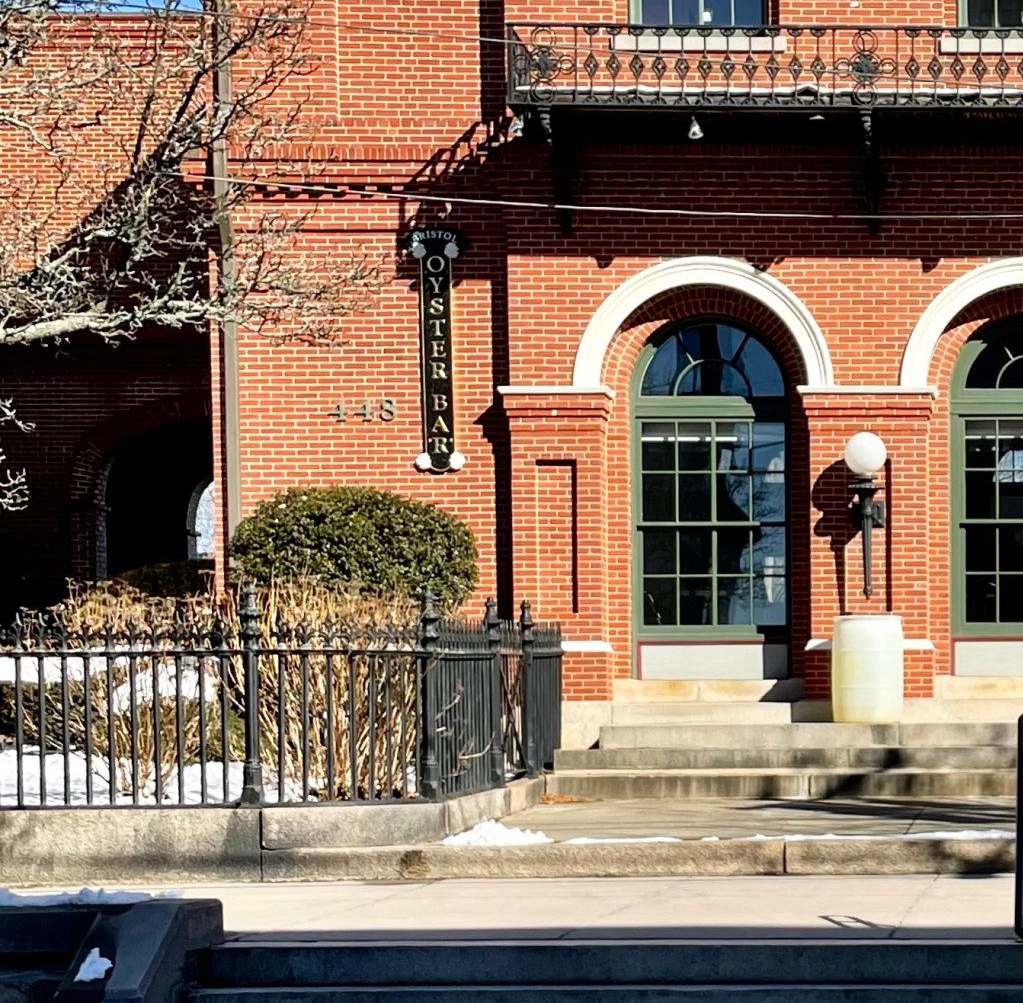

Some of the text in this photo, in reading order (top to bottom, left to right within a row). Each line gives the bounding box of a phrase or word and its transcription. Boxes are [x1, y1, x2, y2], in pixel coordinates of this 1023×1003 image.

[327, 398, 395, 422] 448
[427, 256, 449, 454] OYSTER BAR
